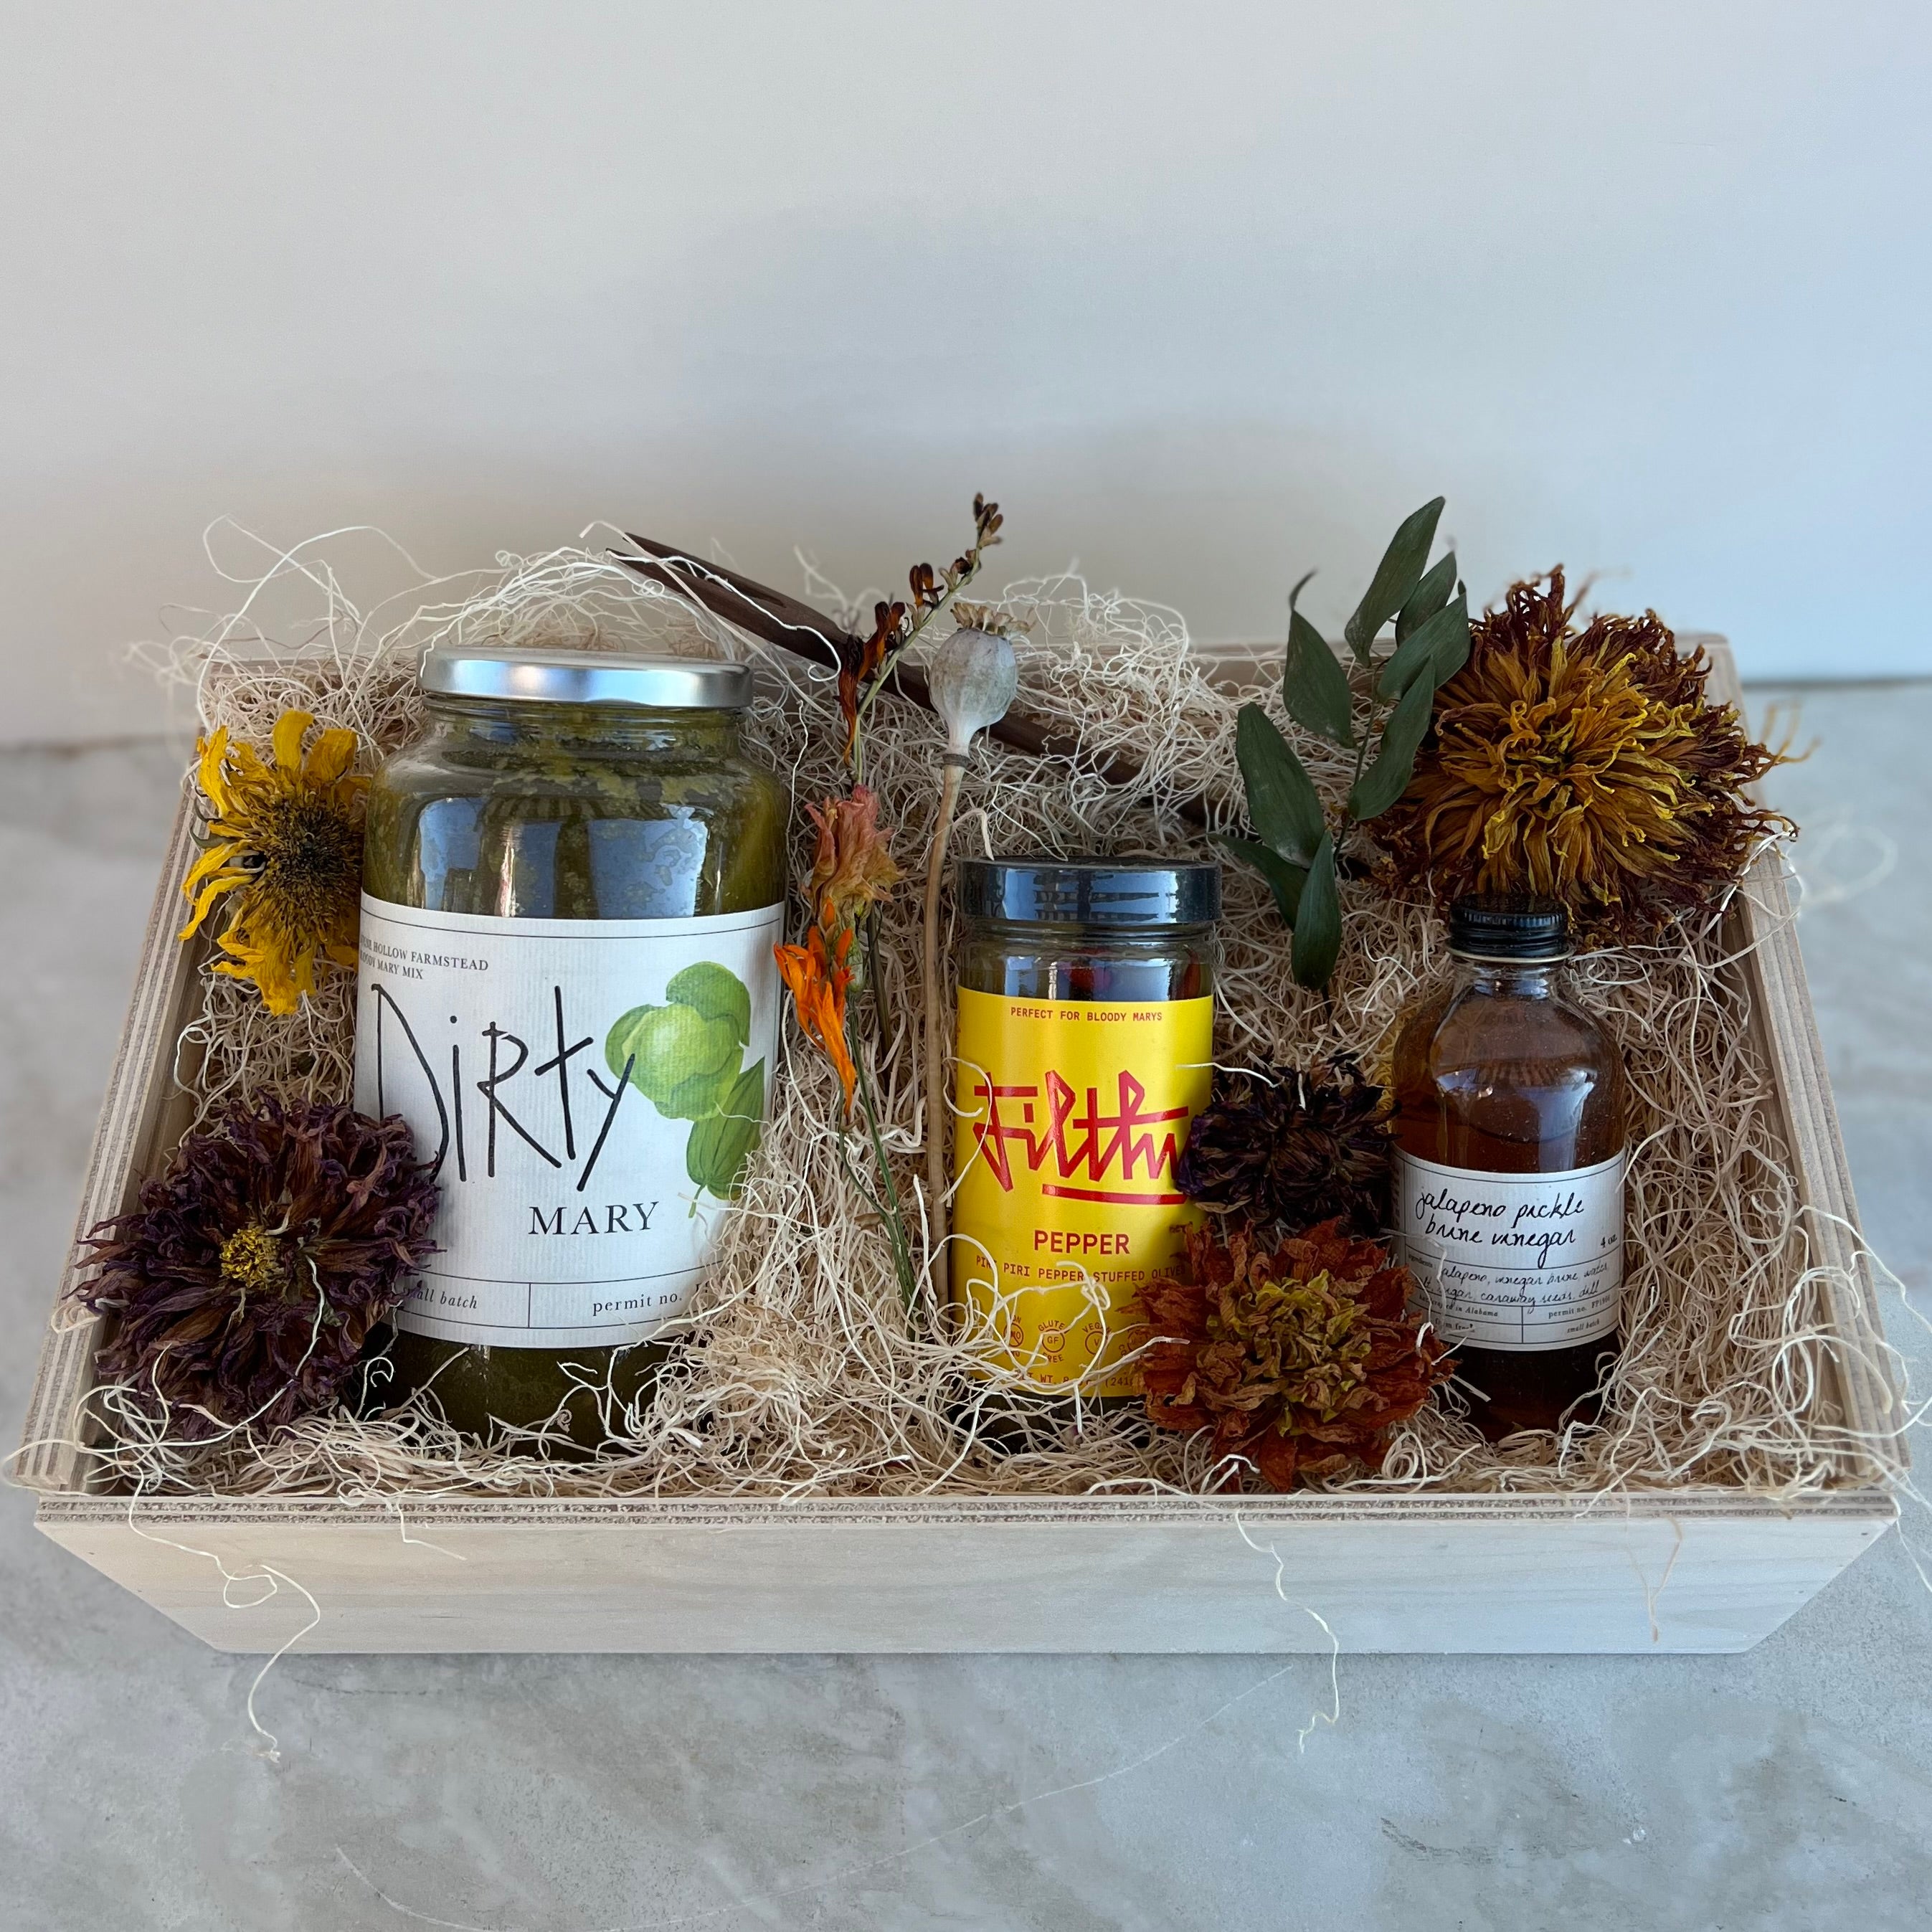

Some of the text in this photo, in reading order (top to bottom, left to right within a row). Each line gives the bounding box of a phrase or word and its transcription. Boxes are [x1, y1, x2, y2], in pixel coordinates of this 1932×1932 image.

[360, 949, 423, 980] LOODY MARY MIX
[374, 941, 407, 960] HOLLOW
[411, 951, 488, 971] FARMSTEAD
[1010, 1007, 1162, 1021] PERFECT FOR BLOODY MARYS
[1416, 1186, 1584, 1228] jalapeno pickle
[528, 1202, 659, 1236] MARY
[1034, 1229, 1130, 1254] PEPPER
[1492, 1229, 1576, 1269] vinegar
[1600, 1236, 1606, 1249] 4
[1003, 1263, 1030, 1277] PIRI
[1038, 1267, 1084, 1282] PEPPER
[1093, 1270, 1145, 1282] STUFFED
[440, 1291, 477, 1309] batch
[592, 1293, 682, 1316] permit no.
[1465, 1307, 1498, 1317] Alabama
[1548, 1307, 1574, 1319] permit
[1038, 1320, 1069, 1334] GLUTE
